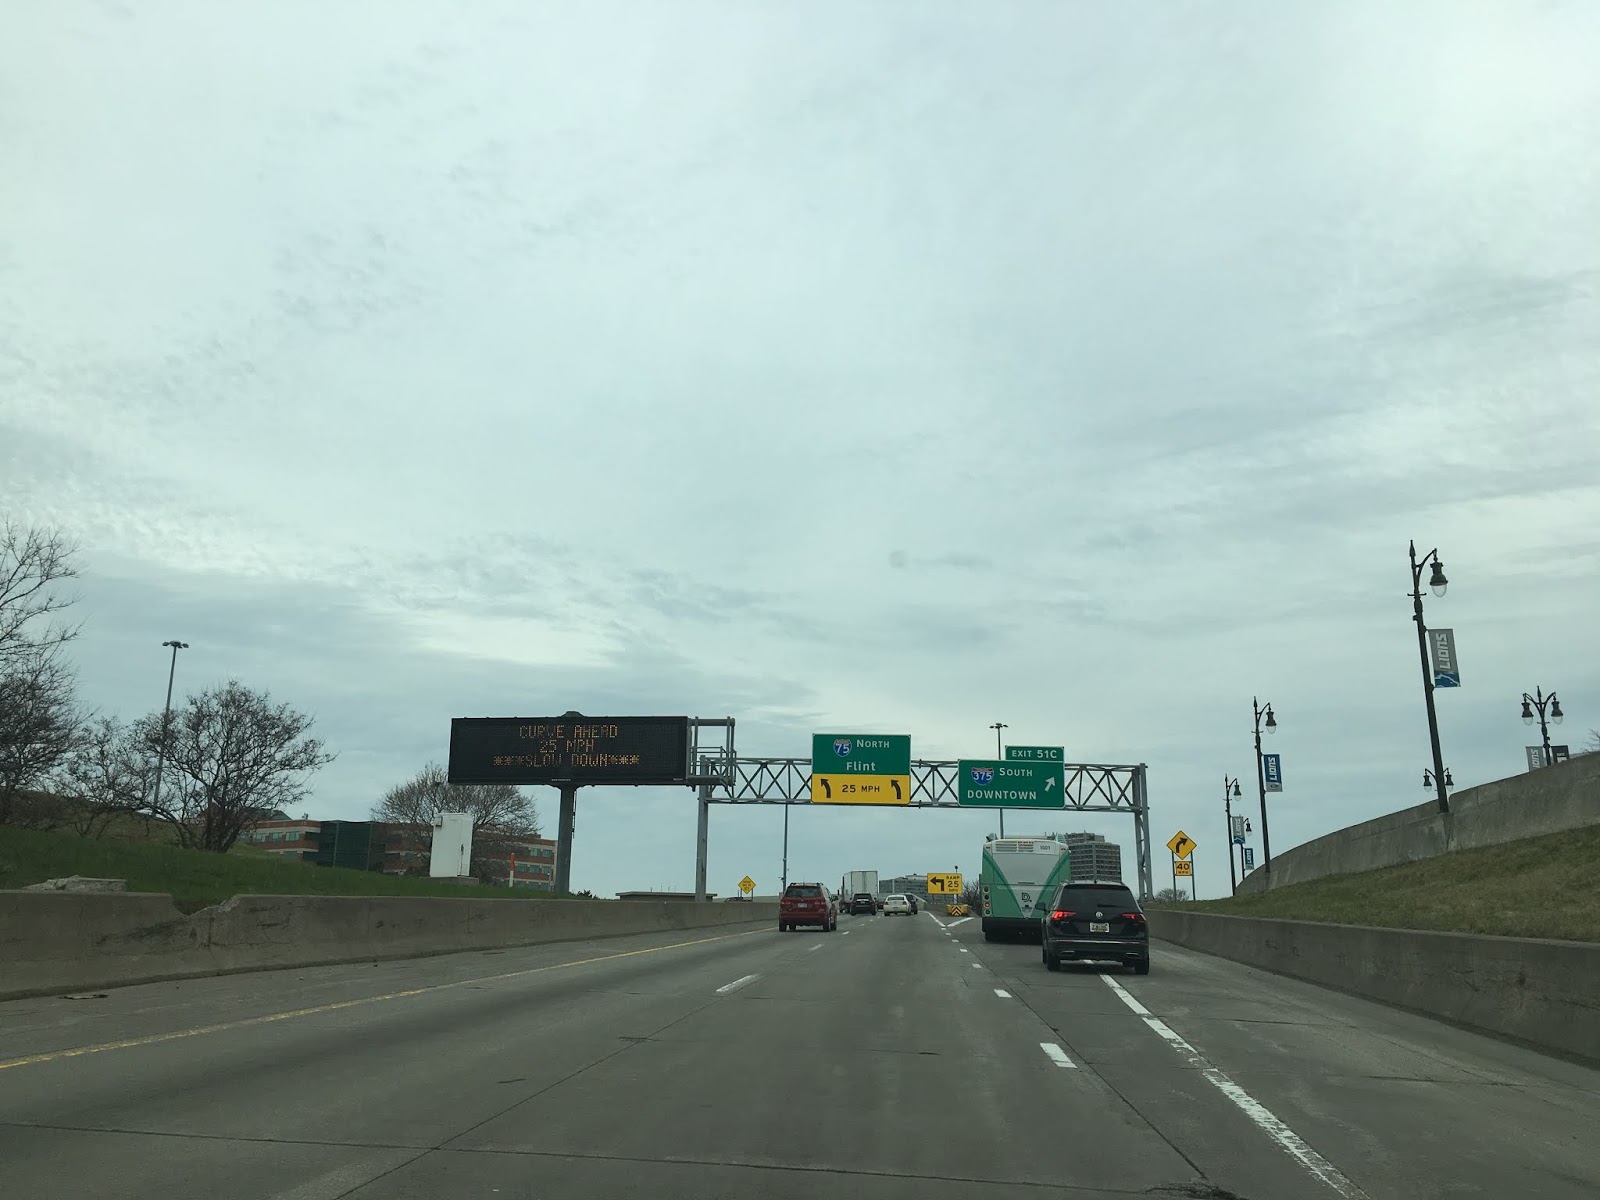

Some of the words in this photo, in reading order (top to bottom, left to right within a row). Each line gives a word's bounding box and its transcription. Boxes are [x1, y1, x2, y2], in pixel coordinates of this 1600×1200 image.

[520, 725, 564, 738] CURVE
[574, 725, 618, 738] AHEAD
[540, 739, 557, 752] 25
[566, 739, 594, 752] MPH
[836, 743, 850, 754] 75
[856, 739, 890, 748] NORTH
[1011, 750, 1032, 758] EXIT
[1037, 750, 1057, 758] 51C
[846, 761, 876, 771] Flint
[973, 771, 992, 781] 375
[999, 767, 1033, 777] SOUTH
[842, 784, 856, 793] 25
[861, 785, 880, 793] MPH
[967, 789, 1037, 800] DOWNTOWN
[947, 880, 959, 888] 25
